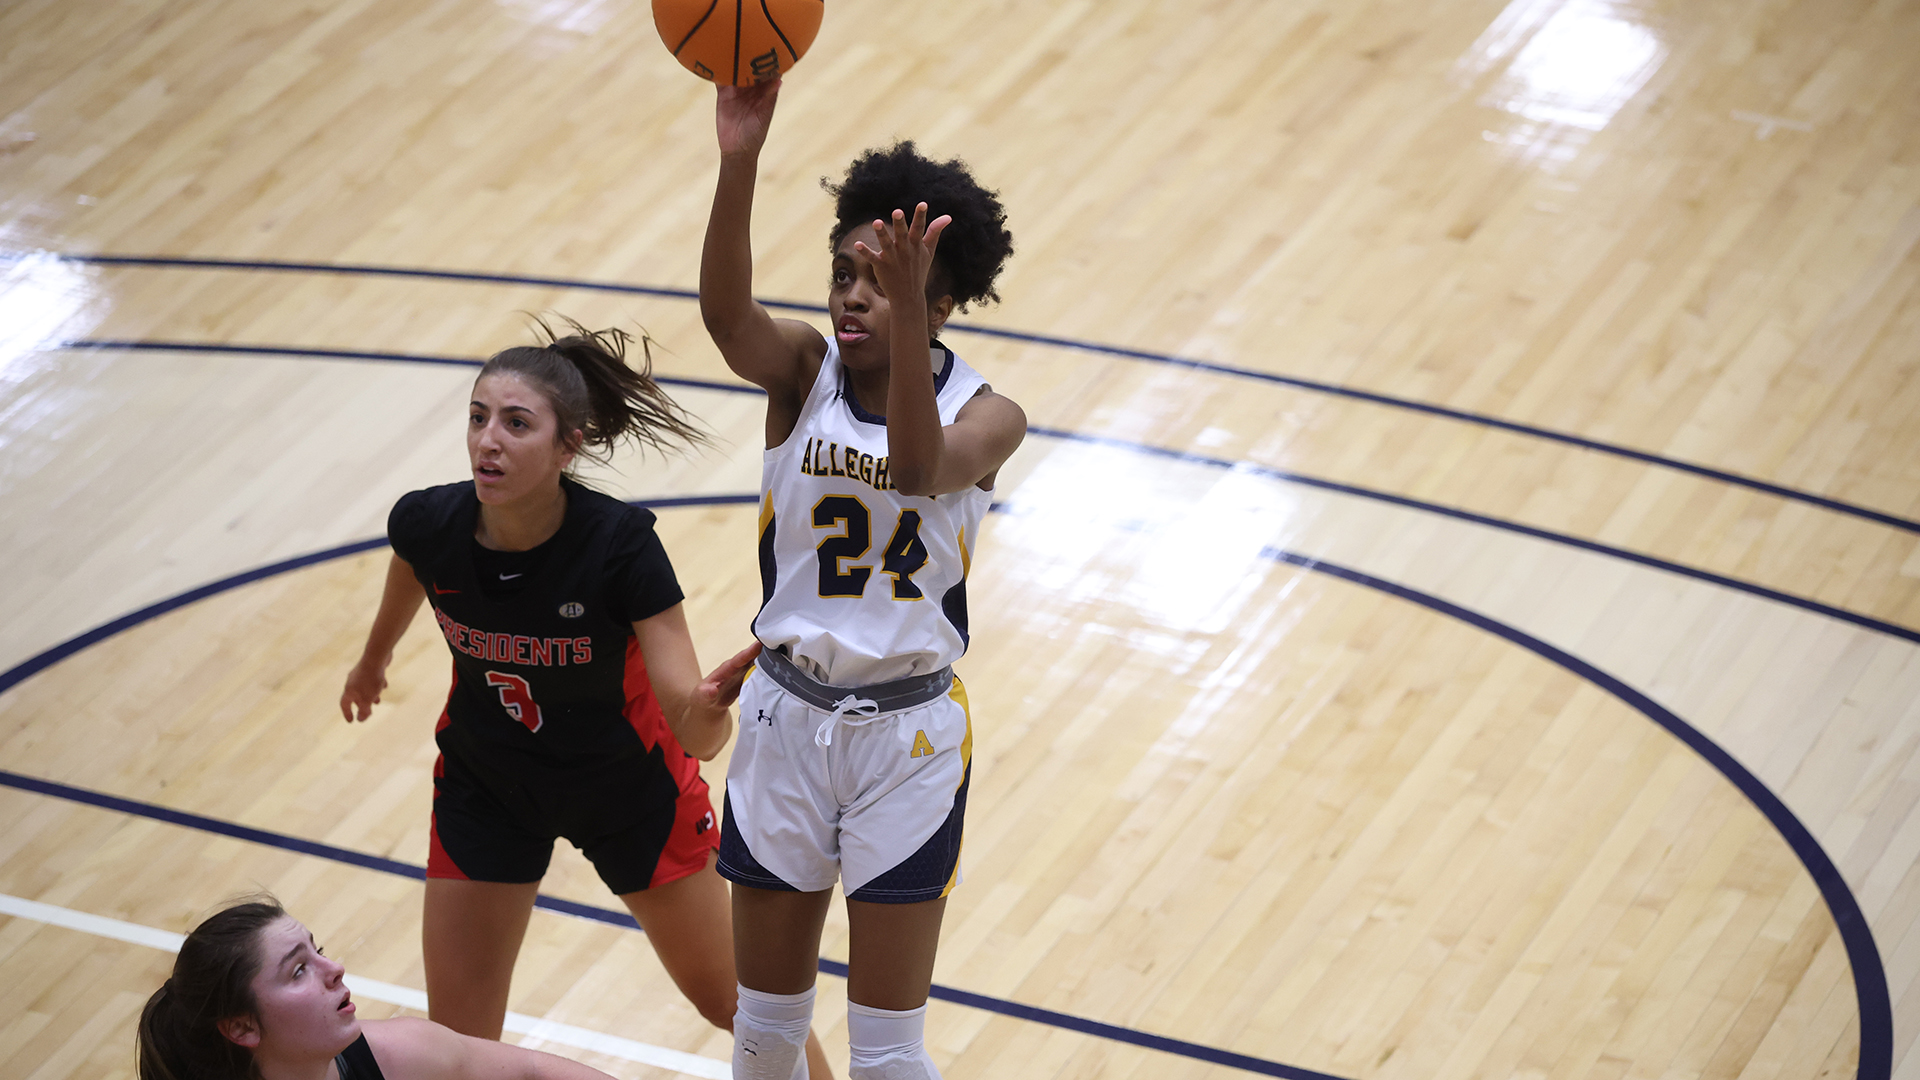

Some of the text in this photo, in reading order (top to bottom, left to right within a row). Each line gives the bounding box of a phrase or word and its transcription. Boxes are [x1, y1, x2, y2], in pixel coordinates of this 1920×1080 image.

[801, 437, 936, 501] ALLEGH
[811, 494, 929, 601] 24
[434, 606, 592, 667] PRESIDENTS
[485, 670, 544, 733] 3
[910, 730, 935, 758] A
